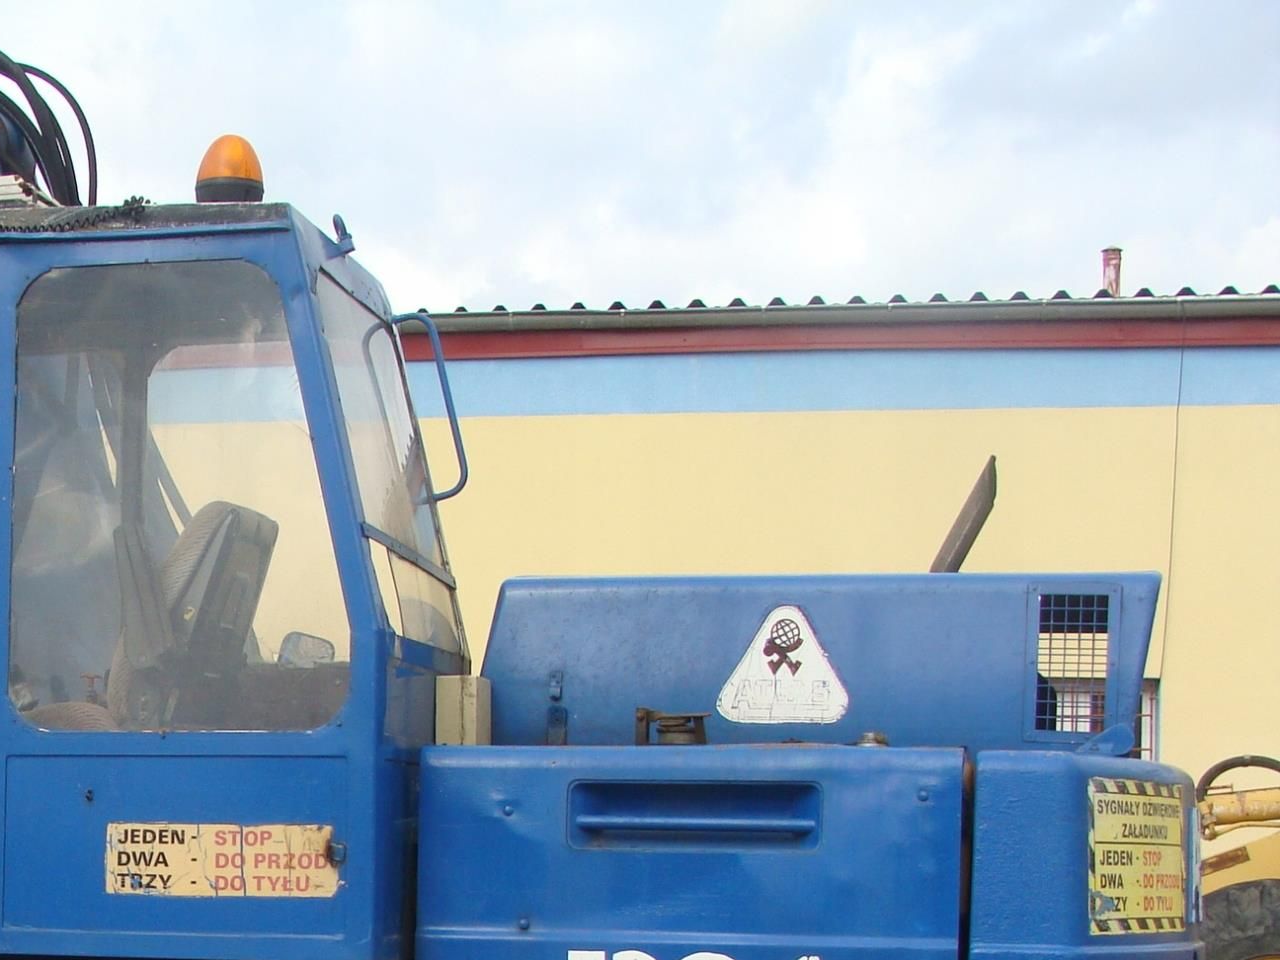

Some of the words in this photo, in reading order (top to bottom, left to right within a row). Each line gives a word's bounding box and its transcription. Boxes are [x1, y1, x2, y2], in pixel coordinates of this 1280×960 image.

[117, 829, 186, 845] JEDEN
[214, 830, 273, 847] STOP
[117, 851, 169, 868] DWA
[215, 853, 246, 869] DO
[1099, 850, 1133, 867] JEDEN
[1142, 850, 1163, 866] STOP
[214, 875, 245, 891] DO
[252, 876, 310, 892] TYŁU
[1100, 873, 1124, 889] DWA
[1143, 873, 1155, 889] DO
[1104, 896, 1128, 912] ZY
[1143, 896, 1155, 911] DO
